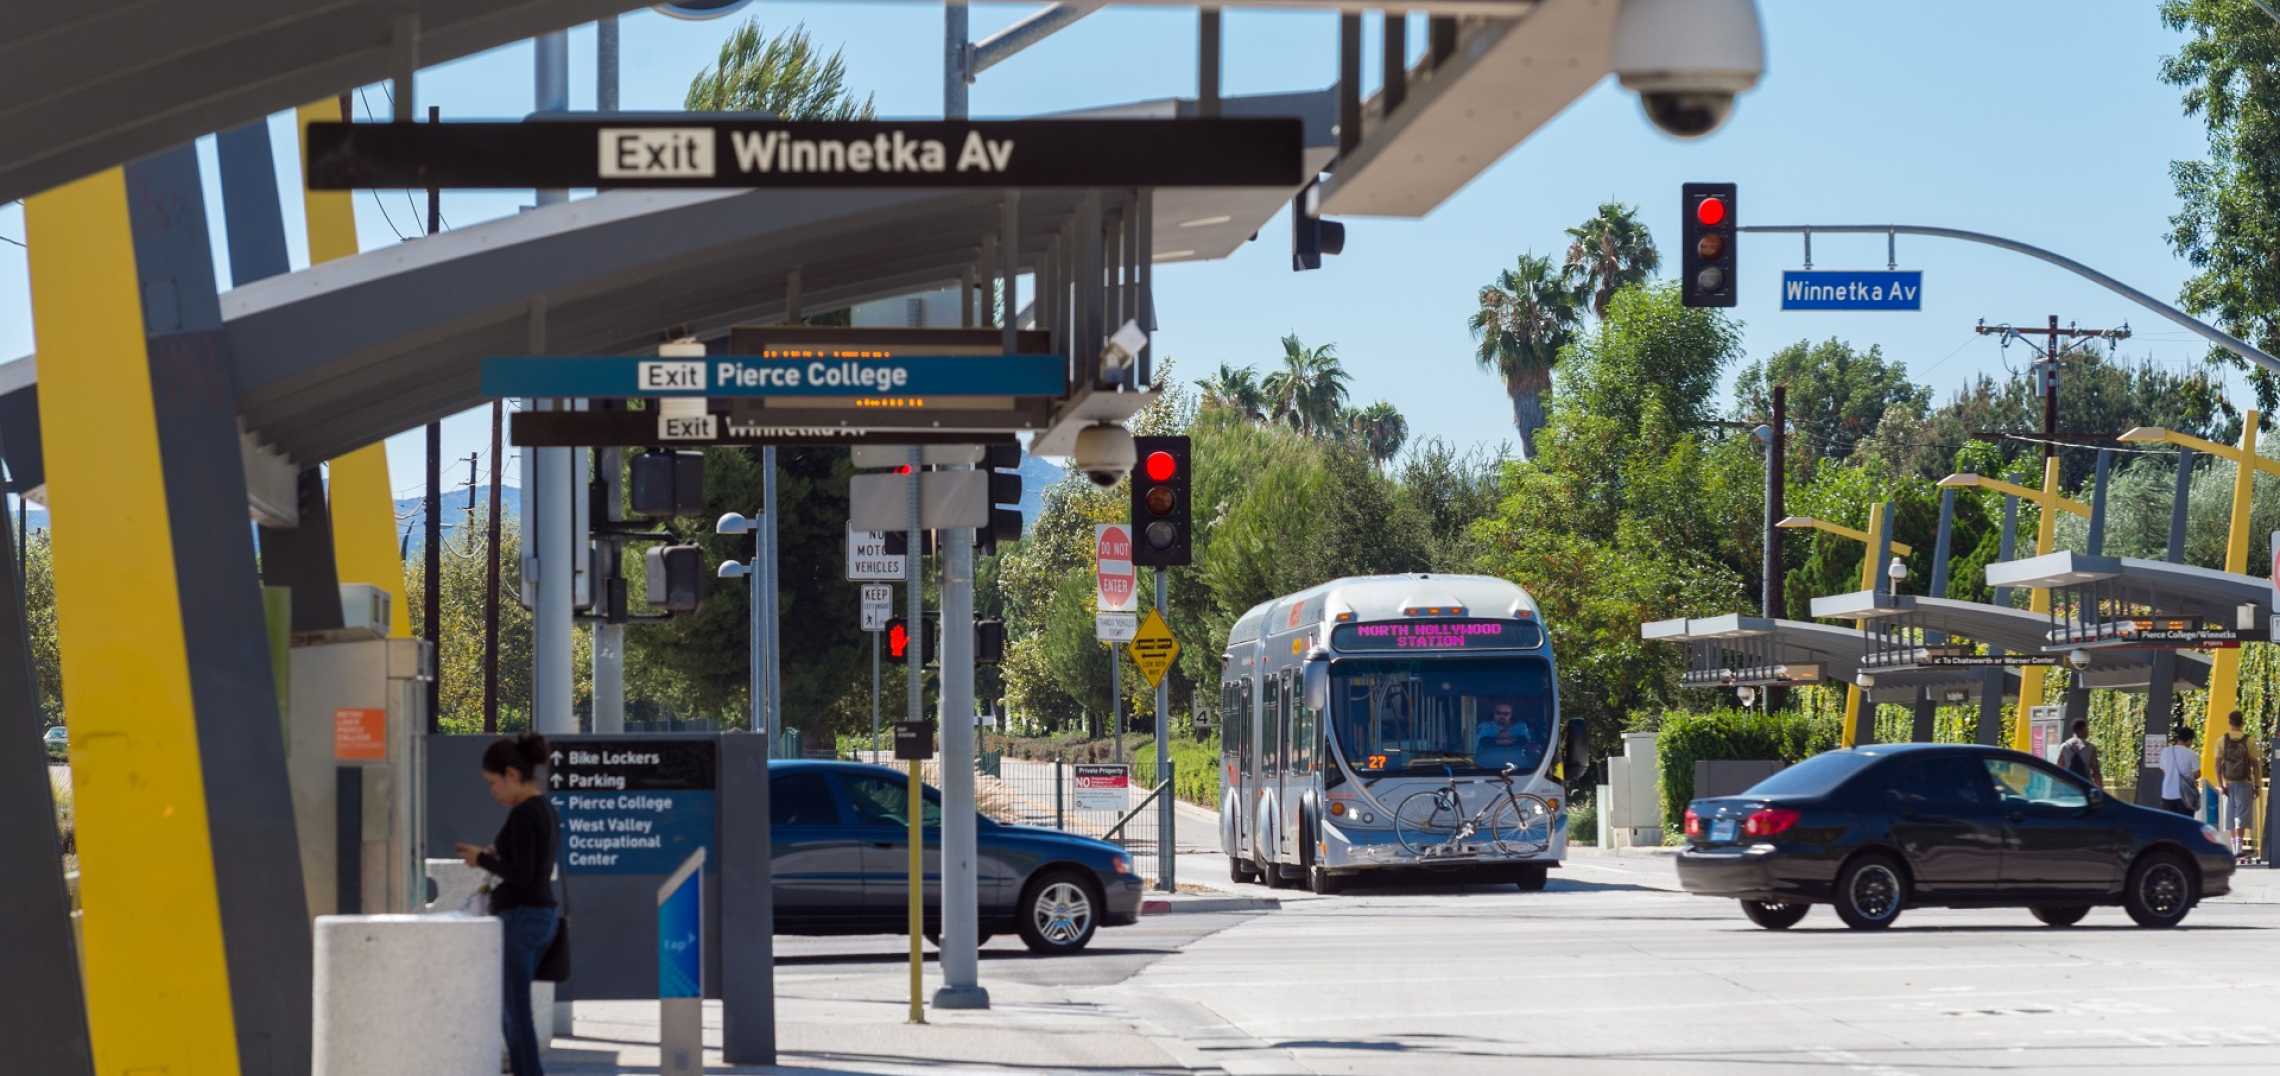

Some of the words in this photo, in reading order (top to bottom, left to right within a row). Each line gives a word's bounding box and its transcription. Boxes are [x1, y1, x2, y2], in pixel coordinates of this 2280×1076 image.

[615, 134, 698, 171] Exit
[731, 130, 946, 173] Winnetka
[956, 130, 1014, 173] Av
[1786, 280, 1883, 301] Winnetka
[1887, 280, 1917, 301] Av
[648, 364, 698, 387] Exit
[716, 361, 800, 387] Pierce
[807, 362, 908, 391] College
[666, 416, 710, 437] Exit
[1101, 542, 1110, 555] DO
[1113, 543, 1129, 556] NOT
[855, 561, 900, 573] VEHICLES
[1103, 578, 1128, 593] ENTER
[864, 589, 888, 601] KEEP
[1358, 624, 1409, 636] NORTH
[1415, 623, 1502, 635] HOLLYWOOD
[2141, 630, 2166, 639] Pierce
[1397, 636, 1465, 648] STATION
[1196, 710, 1207, 724] 4
[568, 751, 600, 765] Bike
[602, 751, 661, 765] Lockers
[1368, 755, 1387, 769] 27
[1078, 767, 1098, 775] Private
[568, 773, 626, 790] Parking
[1076, 777, 1090, 788] NO
[568, 795, 616, 810] Pierce
[617, 795, 673, 812] College
[568, 818, 605, 832] West
[607, 818, 653, 834] Valley
[568, 835, 662, 851] Occupational
[568, 852, 619, 866] Center
